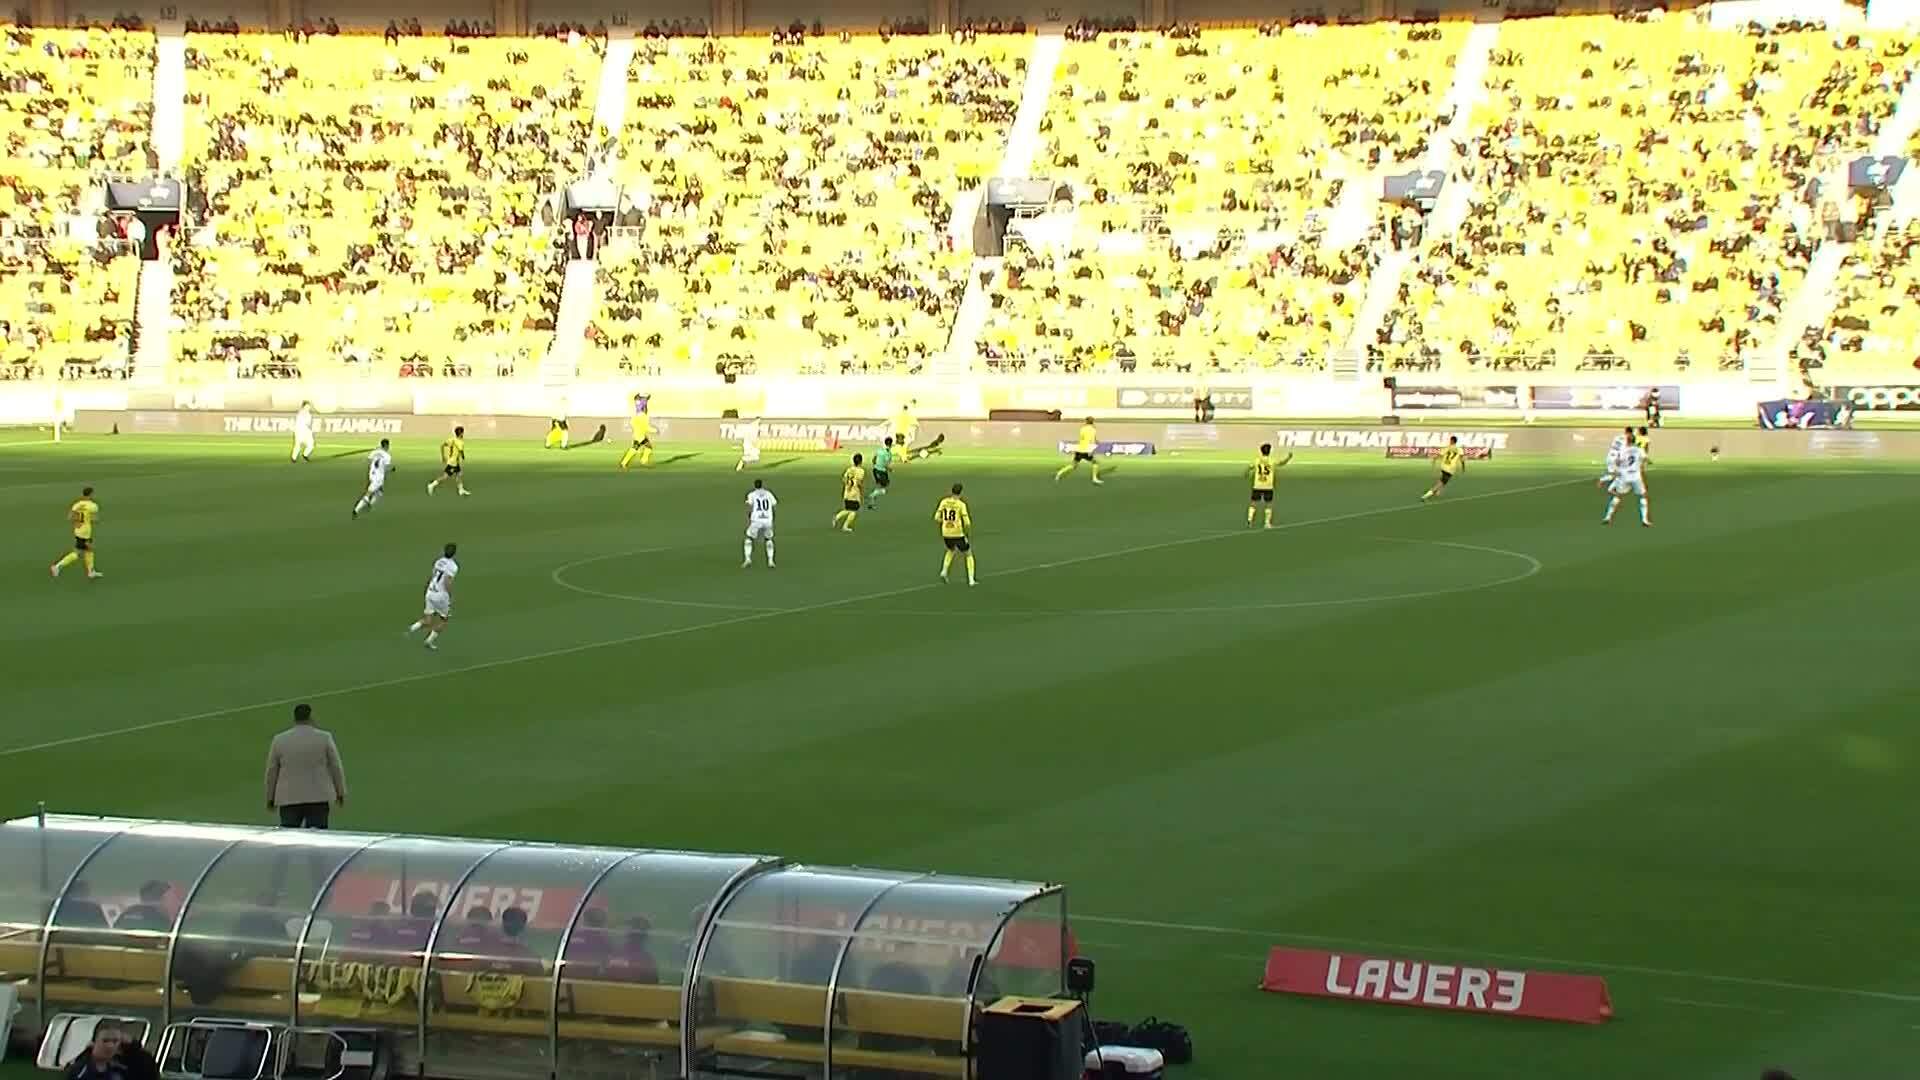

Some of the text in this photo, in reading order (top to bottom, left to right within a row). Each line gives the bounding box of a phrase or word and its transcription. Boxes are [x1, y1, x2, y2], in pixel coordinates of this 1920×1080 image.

[1848, 387, 1920, 408] opp
[223, 416, 251, 431] THE
[1277, 430, 1313, 446] THE
[1315, 430, 1401, 447] ULTIMATE
[756, 498, 769, 511] 10
[943, 508, 956, 521] 18
[1326, 955, 1526, 1011] LAYER3
